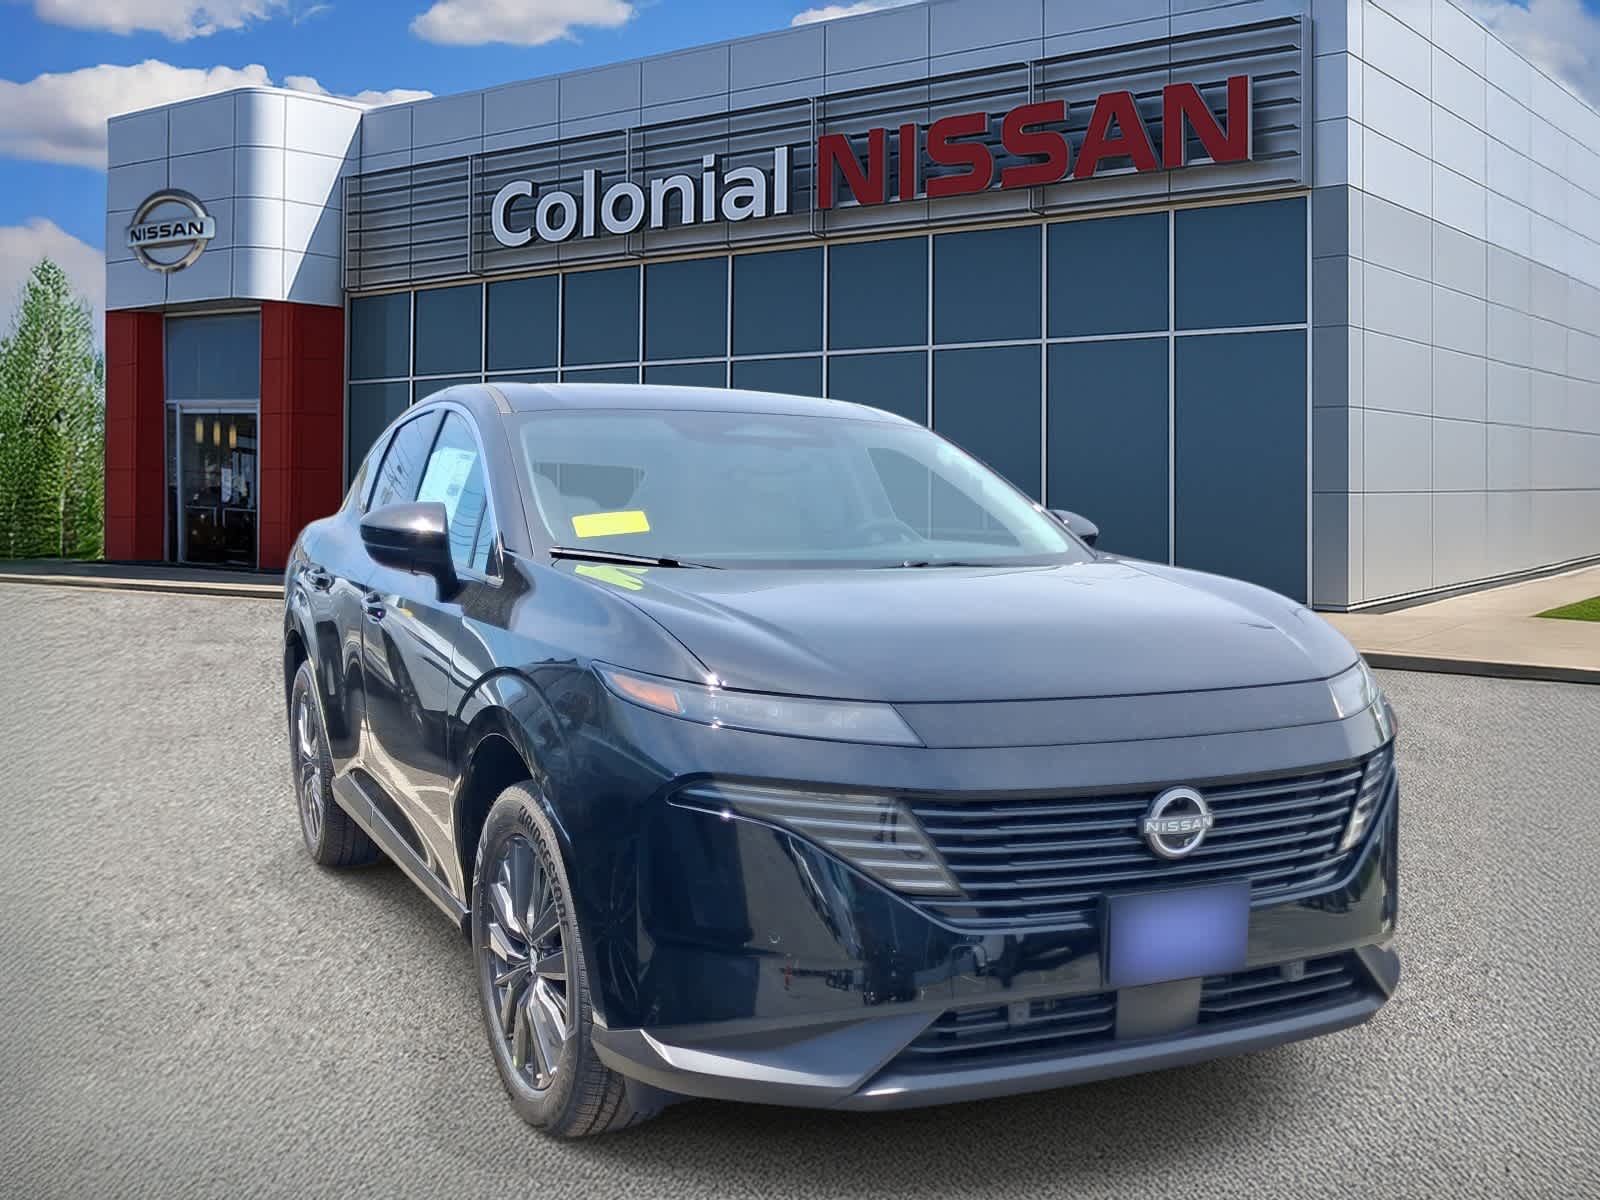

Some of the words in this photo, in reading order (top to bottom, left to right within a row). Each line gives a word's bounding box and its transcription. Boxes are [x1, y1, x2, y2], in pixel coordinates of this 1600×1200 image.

[491, 146, 789, 248] Colonial
[817, 74, 1254, 209] NISSAN
[130, 221, 204, 242] NISSAN
[1146, 815, 1212, 832] NISSAN
